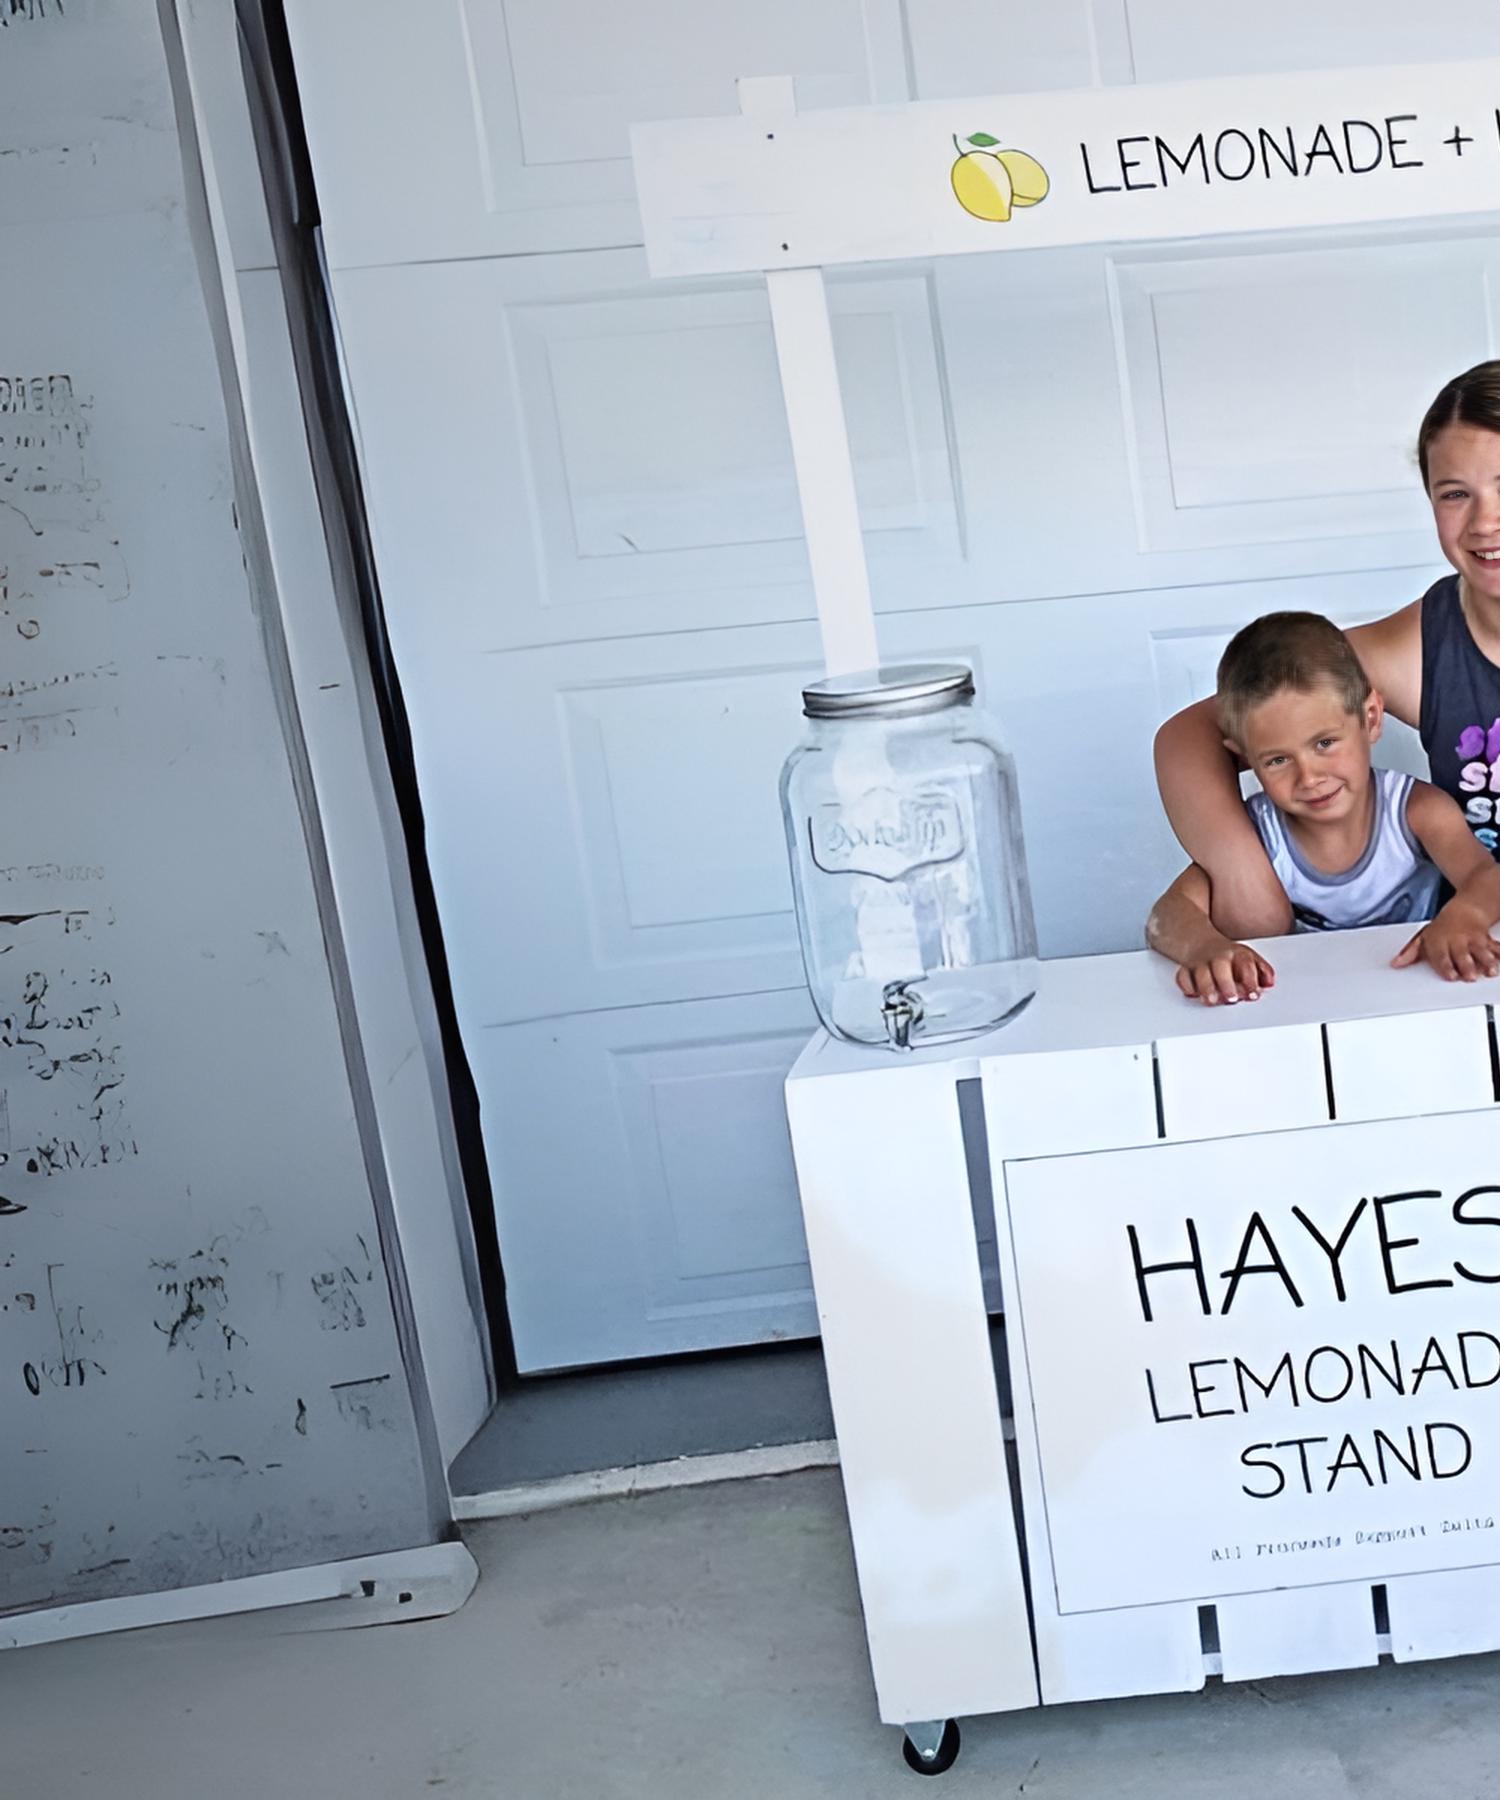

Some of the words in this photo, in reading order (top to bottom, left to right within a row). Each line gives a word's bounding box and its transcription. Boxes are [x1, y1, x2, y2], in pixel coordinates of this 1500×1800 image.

[1081, 114, 1424, 194] LEMONADE
[1443, 126, 1473, 157] +
[1240, 1422, 1472, 1499] STAND
